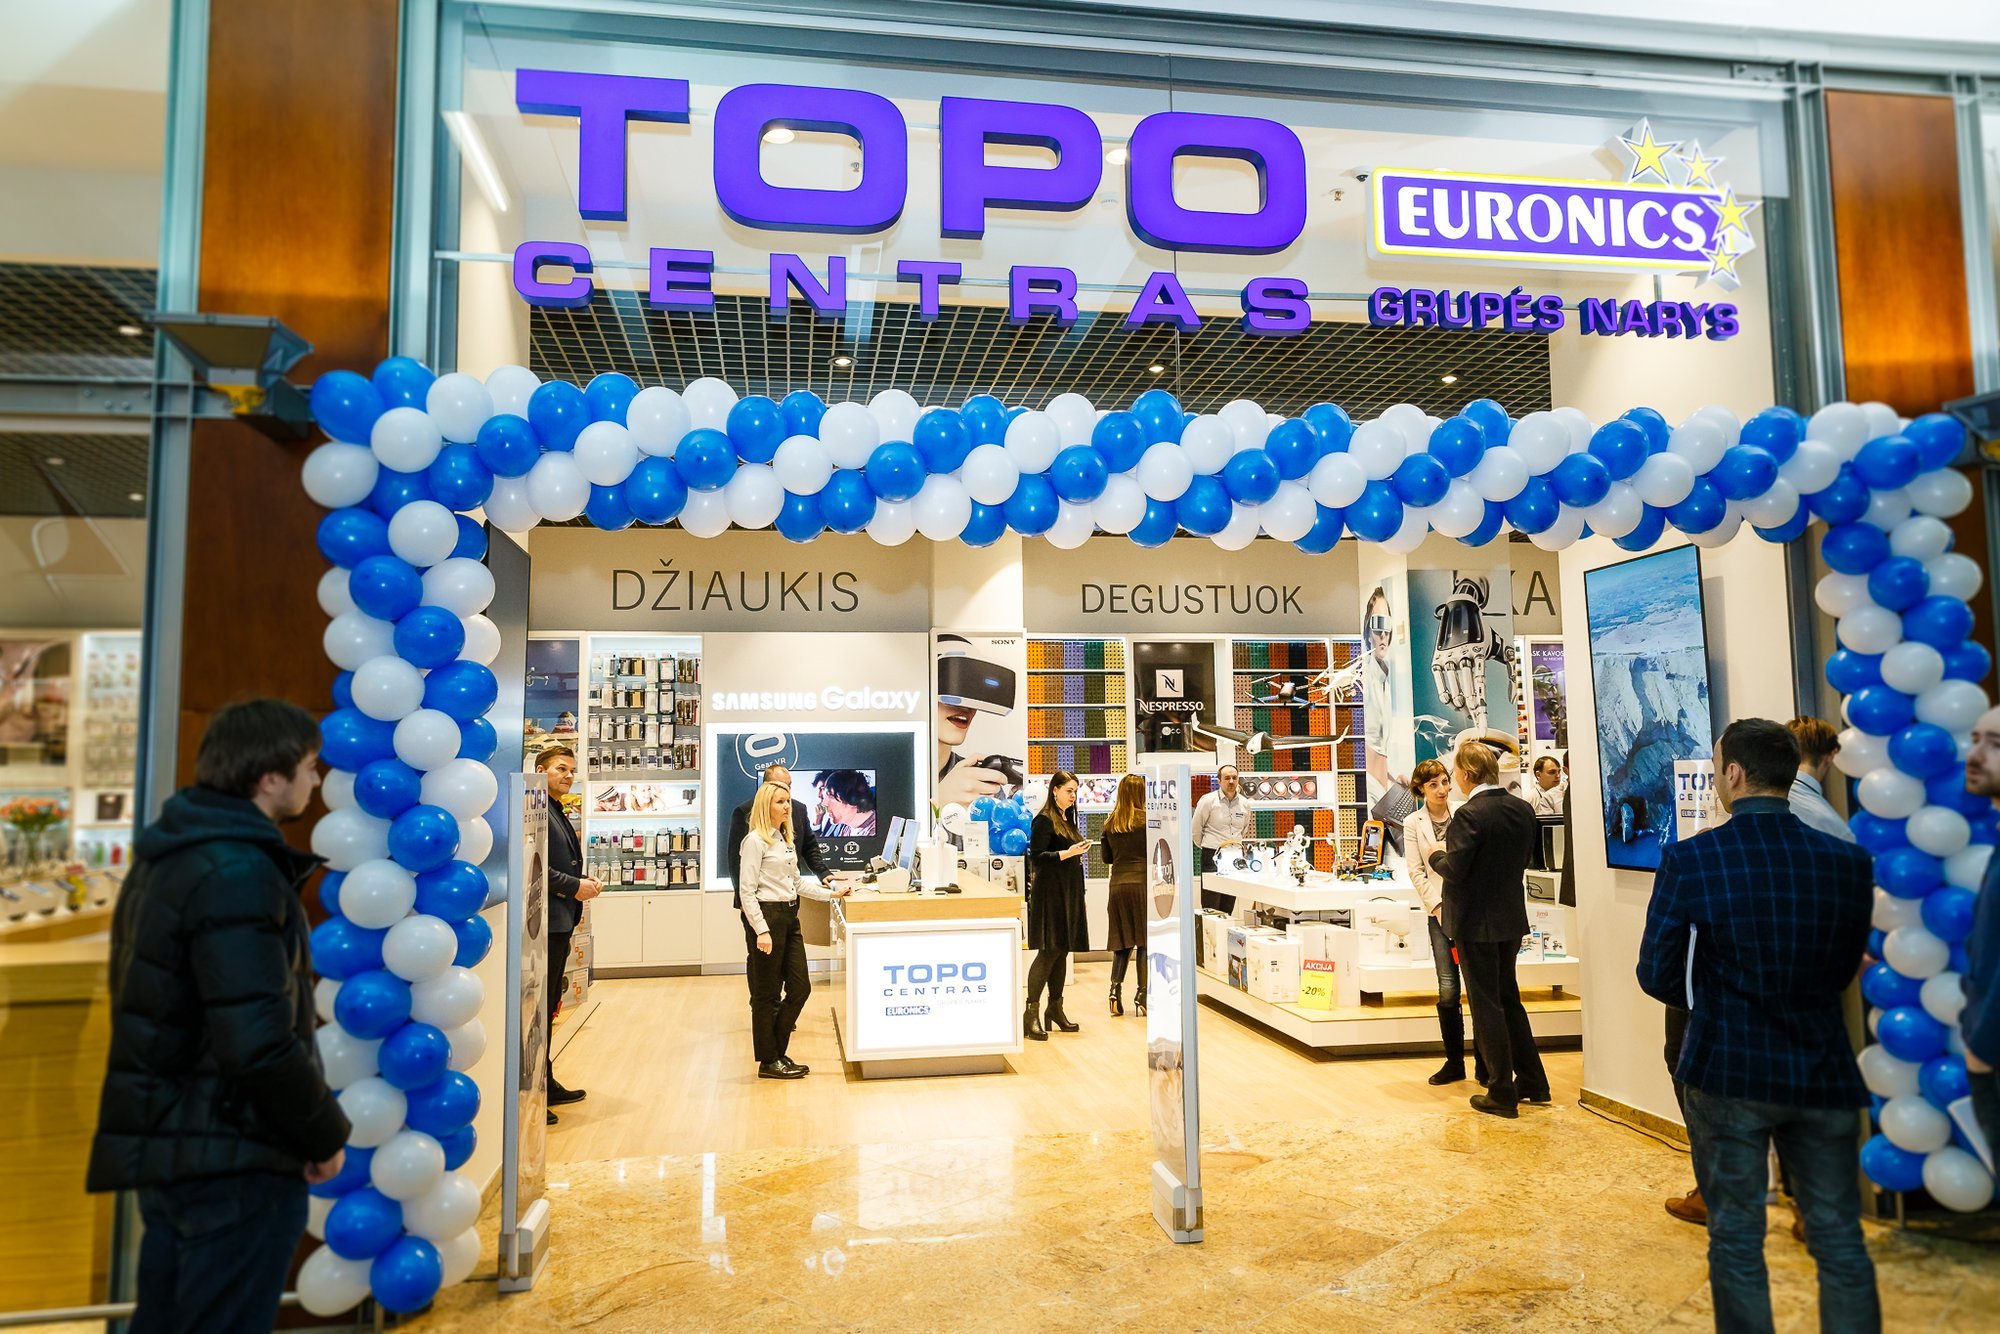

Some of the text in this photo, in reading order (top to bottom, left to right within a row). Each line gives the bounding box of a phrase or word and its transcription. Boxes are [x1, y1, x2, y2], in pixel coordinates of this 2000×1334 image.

[516, 68, 1307, 256] TOPO
[1397, 185, 1706, 251] EURONICS
[513, 241, 1312, 338] CENTRAS
[1578, 297, 1740, 341] NARYS
[611, 558, 860, 613] DŽIAUKIS
[1081, 583, 1304, 615] DEGUSTUOK
[711, 685, 921, 714] SAMSUNG Galaxy
[1135, 698, 1205, 715] NESPRESSO
[774, 757, 786, 765] VR
[883, 962, 987, 984] TOPO
[1304, 962, 1333, 971] AKCIJA
[883, 984, 987, 997] CENTRAS
[1301, 986, 1325, 996] -20%
[886, 1005, 930, 1016] EURONICS
